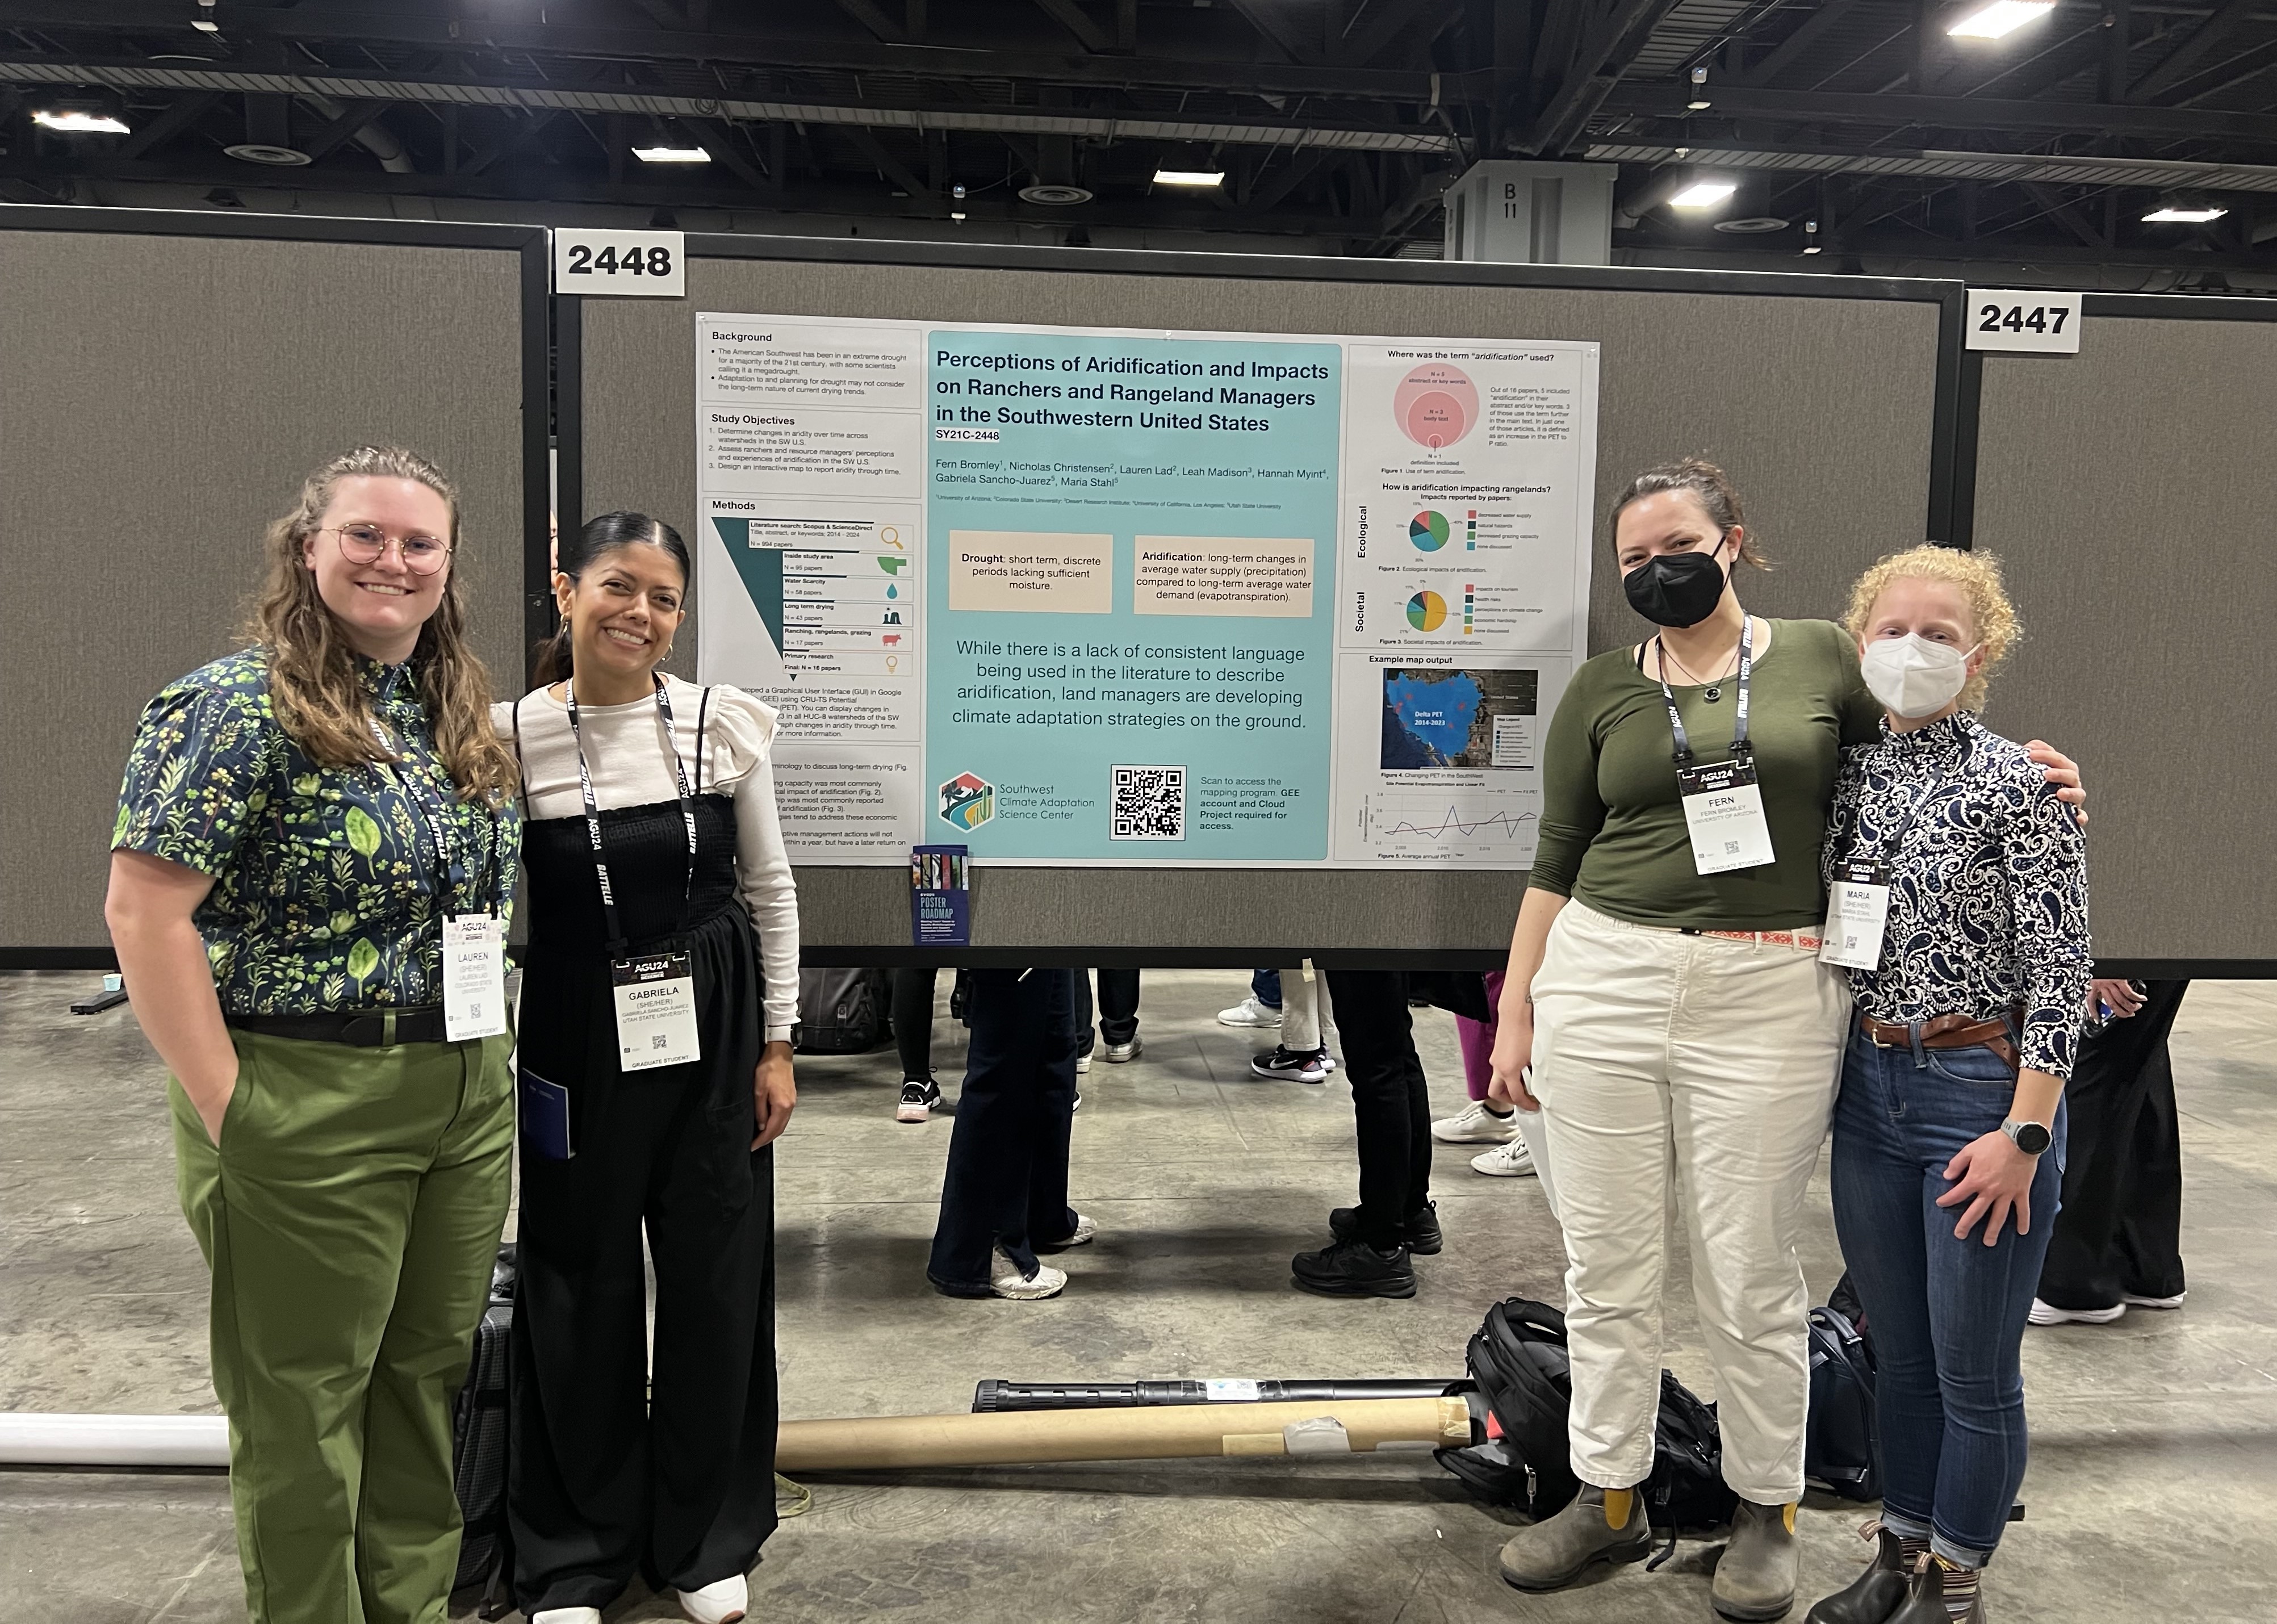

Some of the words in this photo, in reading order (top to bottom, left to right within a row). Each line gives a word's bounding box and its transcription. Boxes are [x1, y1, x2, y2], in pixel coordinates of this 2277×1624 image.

[1505, 183, 1516, 199] B
[1505, 202, 1516, 219] 11
[568, 245, 671, 277] 2448
[1979, 304, 2069, 334] 2447
[712, 331, 772, 342] Background
[718, 366, 740, 374] calling
[937, 350, 1055, 372] Perceptions
[1061, 356, 1081, 371] of
[1086, 357, 1203, 375] Aridification
[1209, 361, 1245, 377] and
[1251, 361, 1328, 381] Impacts
[936, 382, 960, 394] on
[968, 379, 1061, 398] Ranchers
[1068, 383, 1103, 399] and
[1111, 384, 1213, 405] Rangeland
[1220, 387, 1315, 408] Managers
[711, 413, 740, 424] Study
[743, 415, 795, 425] Objectives
[936, 404, 953, 421] in
[959, 405, 991, 422] the
[997, 407, 1132, 427] Southwestern
[1140, 412, 1202, 429] United
[1208, 414, 1269, 431] States
[936, 430, 999, 441] SY21C-2448
[936, 459, 957, 468] Fern
[1010, 461, 1050, 471] Nicholas
[1120, 464, 1152, 474] Lauren
[1182, 467, 1205, 476] Leah
[1257, 468, 1294, 478] Hannah
[935, 473, 976, 483] Gabriela
[1061, 477, 1087, 487] Maria
[1460, 484, 1500, 493] impacting
[1502, 485, 1551, 494] rangelands?
[713, 500, 755, 510] Methods
[1358, 506, 1368, 558] Ecological
[962, 553, 1006, 564] Drought:
[1008, 555, 1033, 564] short
[1036, 556, 1060, 565] term,
[1063, 556, 1100, 566] discrete
[1142, 551, 1205, 561] Aridification:
[1208, 553, 1253, 564] long-term
[1256, 554, 1295, 565] changes
[972, 567, 1008, 577] periods
[1011, 567, 1044, 579] lacking
[1047, 568, 1090, 578] sufficient
[1141, 566, 1179, 576] average
[1181, 566, 1208, 574] water
[1209, 567, 1241, 577] supply
[1244, 567, 1306, 578] (precipitation)
[1009, 581, 1052, 590] moisture.
[1136, 577, 1183, 588] compared
[1186, 578, 1196, 587] to
[1198, 578, 1244, 589] long-term
[1246, 581, 1283, 591] average
[1285, 580, 1312, 589] water
[1156, 590, 1194, 599] demand
[1197, 591, 1290, 603] (evapotranspiration).
[1355, 592, 1365, 632] Societal
[956, 640, 1002, 655] While
[1006, 641, 1048, 656] there
[1054, 642, 1065, 656] is
[1071, 646, 1081, 657] a
[1087, 643, 1119, 658] lack
[1124, 644, 1140, 658] of
[1145, 645, 1227, 659] consistent
[1232, 646, 1304, 664] language
[1369, 655, 1404, 664] Example
[1425, 656, 1453, 665] output
[977, 663, 1021, 681] being
[1027, 664, 1066, 678] used
[1072, 664, 1085, 679] in
[1090, 665, 1116, 679] the
[1122, 665, 1190, 680] literature
[1195, 668, 1211, 681] to
[1216, 667, 1284, 682] describe
[957, 684, 1055, 702] aridification,
[1062, 686, 1095, 700] land
[1102, 690, 1180, 705] managers
[1186, 692, 1210, 702] are
[1215, 689, 1302, 707] developing
[952, 709, 1011, 723] climate
[1016, 710, 1102, 727] adaptation
[1107, 712, 1185, 729] strategies
[1190, 716, 1209, 726] on
[1215, 713, 1240, 727] the
[1245, 714, 1305, 730] ground.
[1200, 776, 1222, 785] Scan
[1700, 769, 1734, 782] AGU24
[399, 771, 425, 802] AGU24
[999, 784, 1054, 796] Southwest
[1240, 790, 1275, 798] program.
[999, 797, 1037, 806] Climate
[1039, 797, 1094, 809] Adaptation
[1709, 796, 1735, 807] FERN
[999, 810, 1038, 819] Science
[1040, 810, 1074, 819] Center
[1200, 810, 1232, 819] Project
[1234, 811, 1272, 820] required
[588, 818, 602, 851] AGU24
[683, 812, 696, 855] BATTELLE
[596, 864, 614, 906] BATTELLE
[1847, 890, 1870, 900] MARIA
[920, 897, 947, 908] POSTER
[920, 908, 953, 919] ROADMAP
[461, 922, 486, 932] AGU24
[458, 952, 488, 962] LAUREN
[634, 961, 669, 973] AGU24
[629, 987, 679, 1001] GABRIELA
[637, 998, 673, 1009] (SHE/HER)
[632, 1059, 662, 1068] GRADUATE
[664, 1055, 689, 1064] STUDENT
